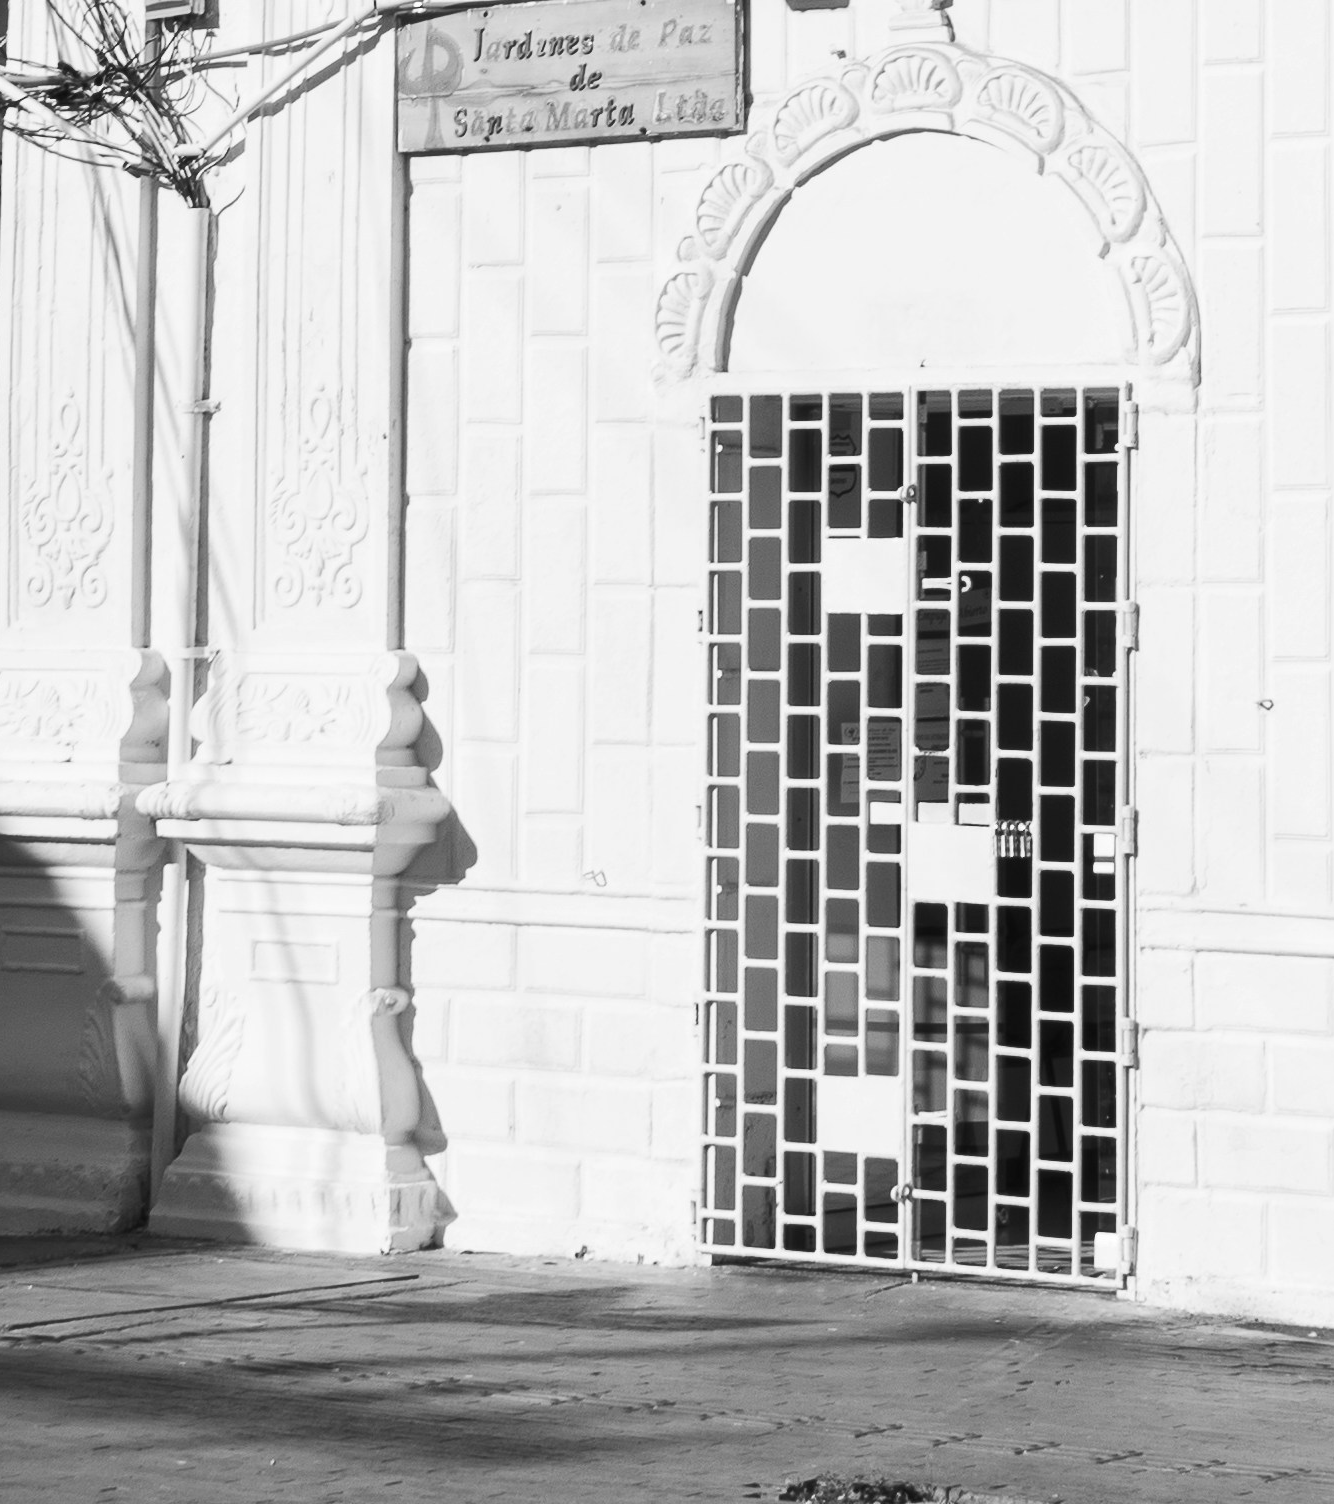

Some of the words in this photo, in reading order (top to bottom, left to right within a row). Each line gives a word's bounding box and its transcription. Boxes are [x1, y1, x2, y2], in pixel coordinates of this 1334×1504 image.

[472, 27, 595, 63] Jardines
[609, 22, 642, 53] de
[659, 17, 715, 48] Paz
[569, 62, 603, 92] de
[453, 105, 538, 139] Santa
[544, 97, 636, 132] Marta
